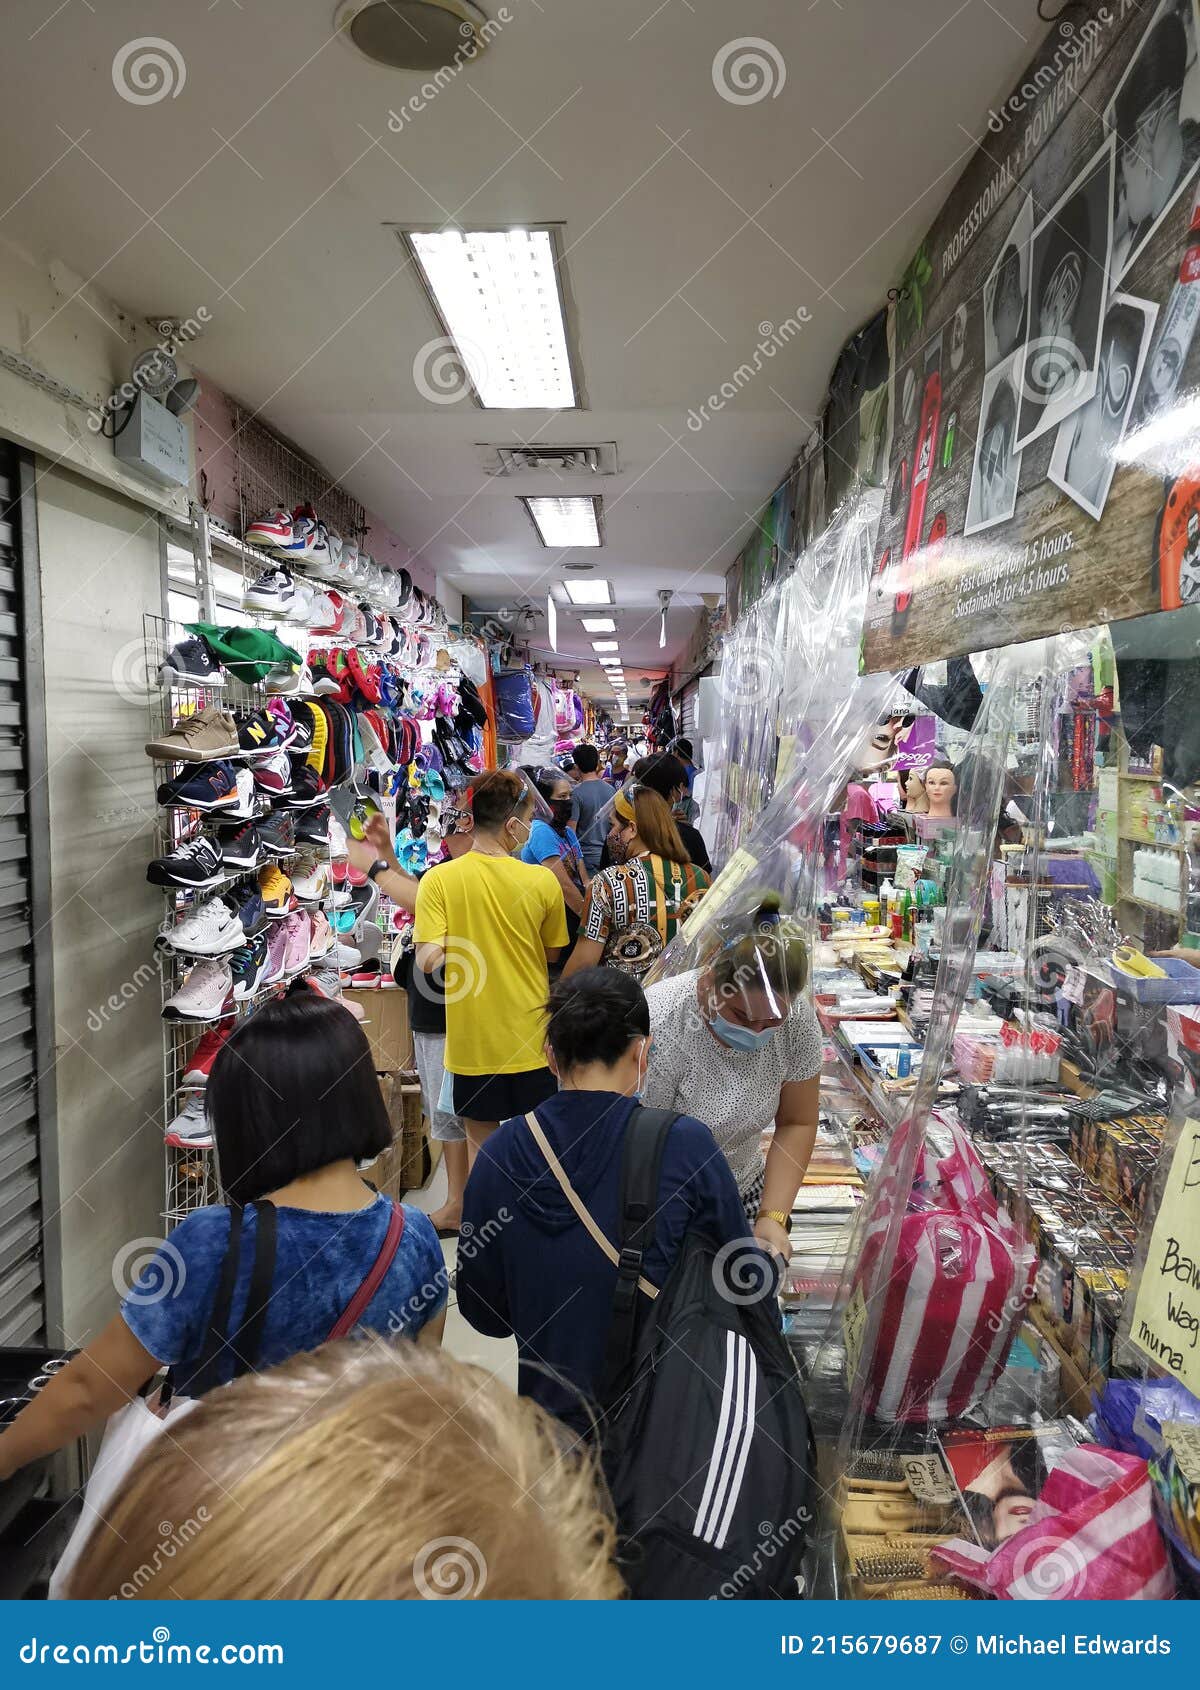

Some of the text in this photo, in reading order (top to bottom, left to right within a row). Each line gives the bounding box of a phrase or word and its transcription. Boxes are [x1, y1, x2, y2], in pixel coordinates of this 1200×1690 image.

[942, 155, 1013, 278] PROFESSIONAL
[1024, 29, 1104, 160] POWERFUL
[1024, 540, 1039, 568] 1.5
[1040, 530, 1074, 561] hours.
[954, 582, 1001, 618] Sustainable
[1002, 579, 1018, 602] for
[1019, 570, 1035, 597] 4.5
[1035, 563, 1070, 591] hours.
[195, 847, 218, 877] N
[1138, 1320, 1187, 1375] muna.
